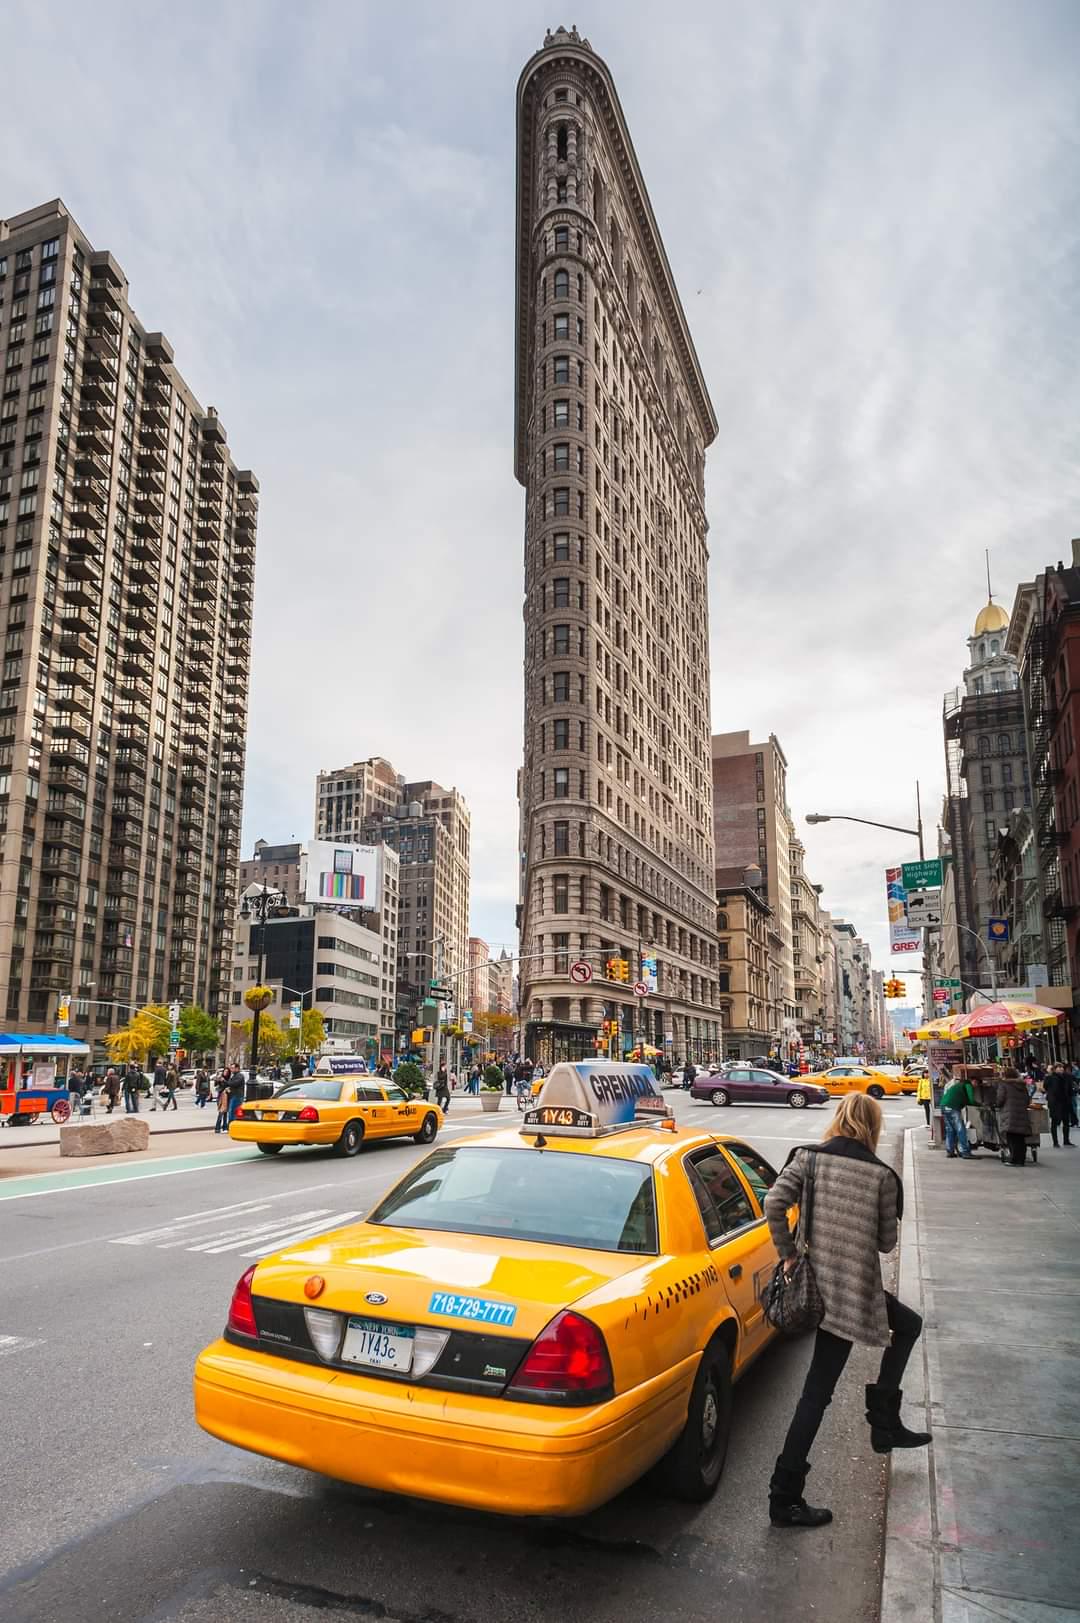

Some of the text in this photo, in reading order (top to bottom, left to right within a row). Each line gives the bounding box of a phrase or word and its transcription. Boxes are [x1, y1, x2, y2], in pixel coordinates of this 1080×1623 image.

[904, 862, 940, 872] West Side
[906, 869, 938, 879] Highway
[892, 941, 920, 951] GREY
[589, 1074, 656, 1102] GRENADA
[542, 1109, 573, 1125] 1Y43
[432, 1293, 515, 1323] 718-729-7777
